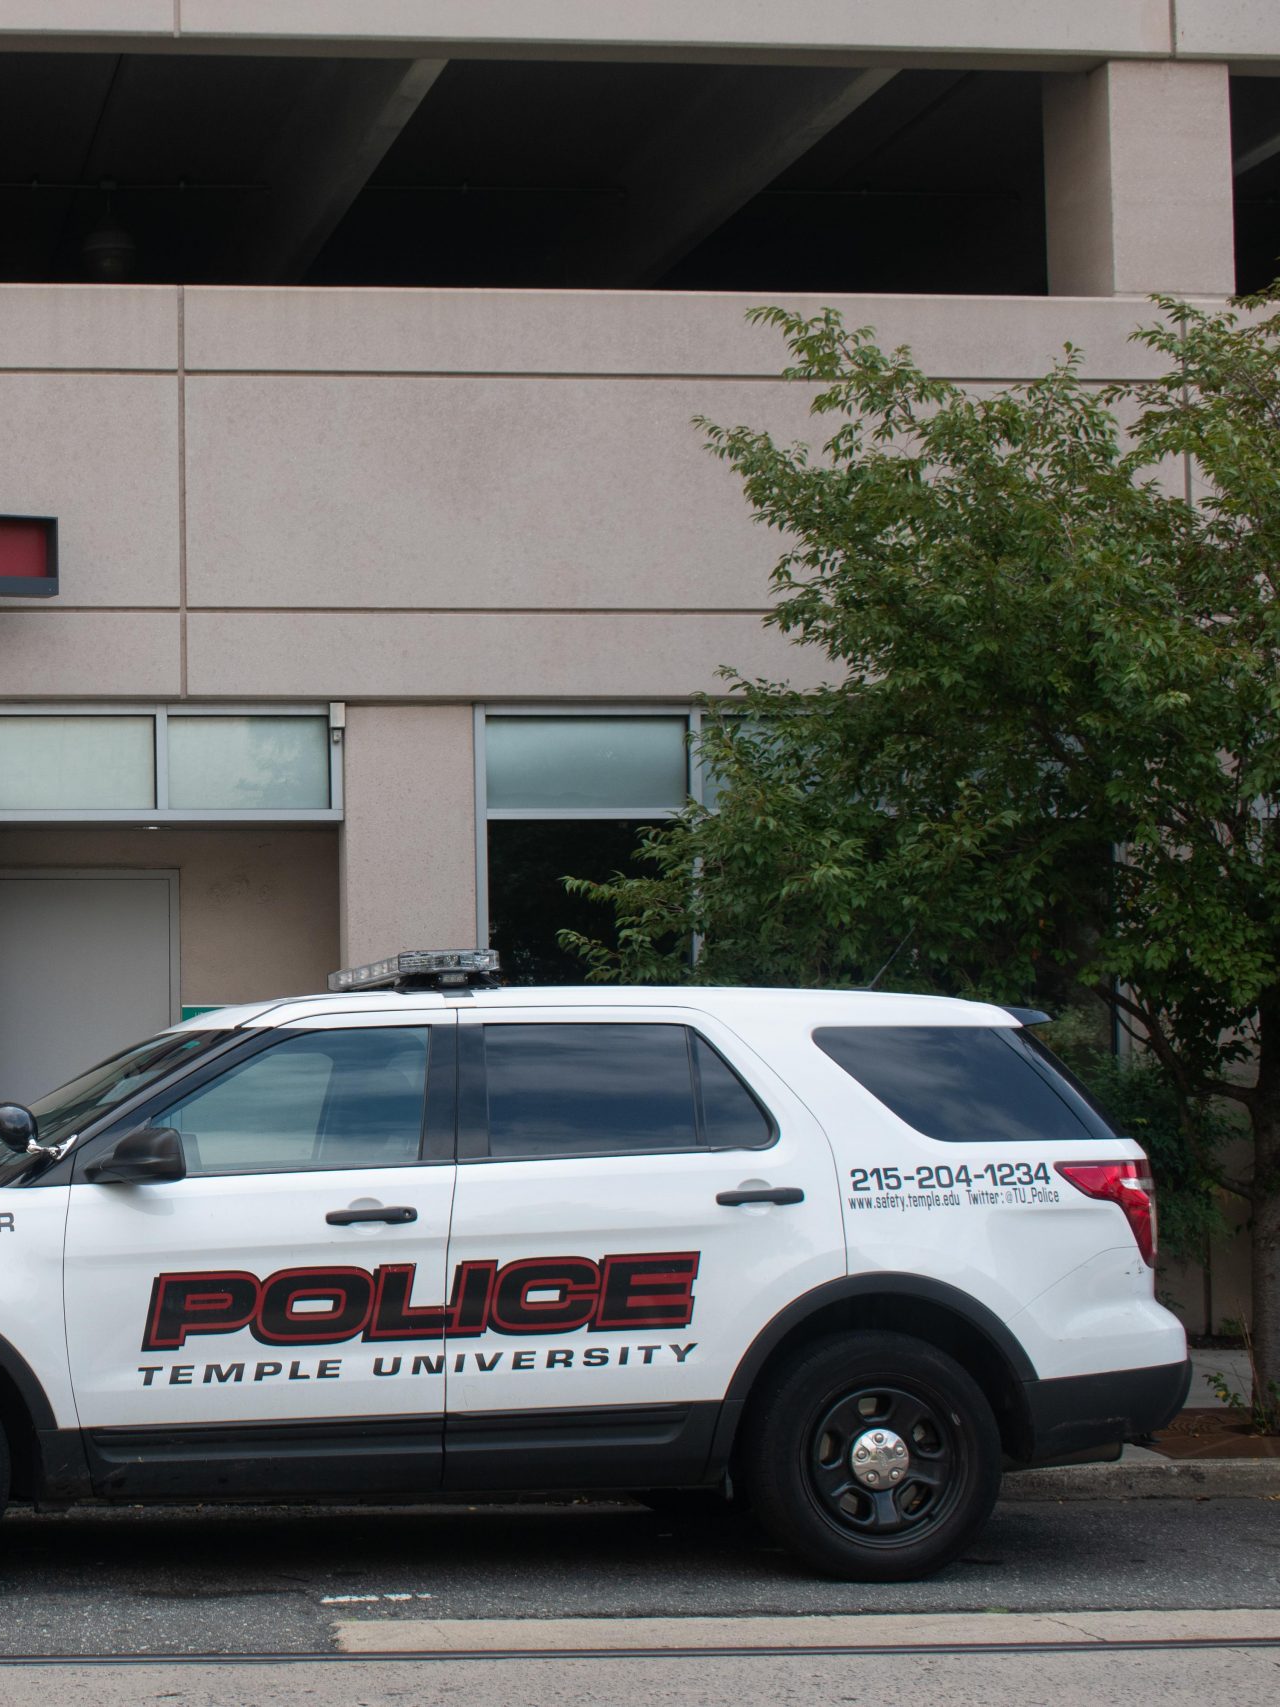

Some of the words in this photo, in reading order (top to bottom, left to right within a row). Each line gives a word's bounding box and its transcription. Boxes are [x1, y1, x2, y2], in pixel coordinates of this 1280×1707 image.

[850, 1162, 1051, 1191] 215-204-1234
[848, 1189, 960, 1212] www.safety.temple.edu
[141, 1251, 701, 1352] POLICE
[138, 1359, 343, 1386] TEMPLE
[372, 1342, 699, 1377] UNIVERSITY
